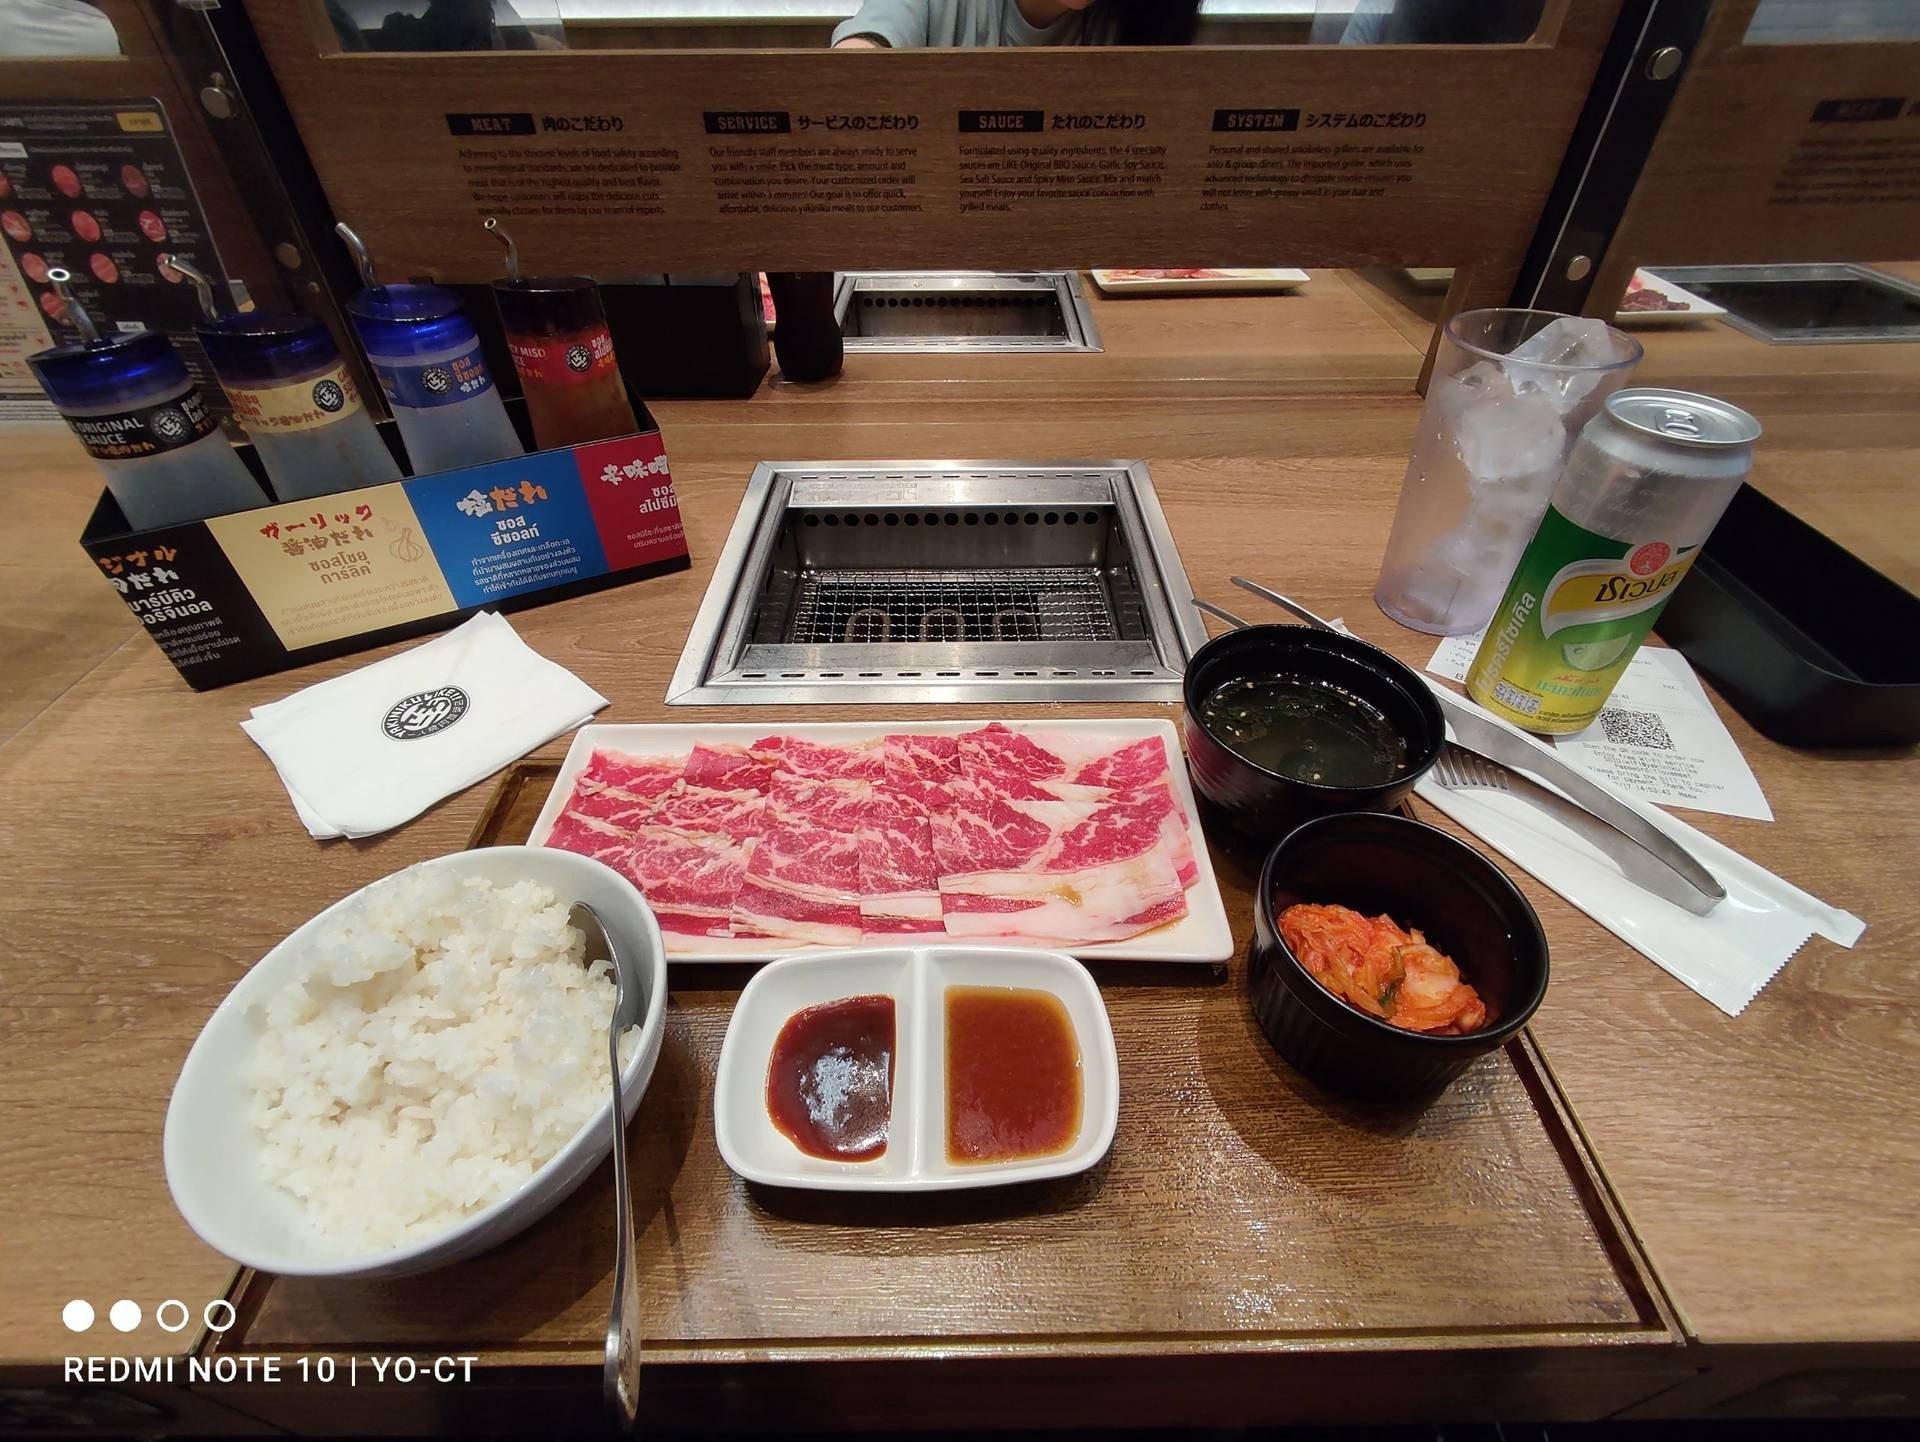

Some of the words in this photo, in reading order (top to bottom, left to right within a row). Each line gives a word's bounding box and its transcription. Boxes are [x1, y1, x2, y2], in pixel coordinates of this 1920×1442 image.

[470, 118, 512, 131] MEAT
[718, 116, 777, 130] SERVICE
[797, 115, 918, 130] サービスのこだわり
[979, 115, 1024, 129] SAUCE
[1052, 114, 1145, 129] たれのこだわり
[1228, 114, 1285, 127] SYSTEM
[1306, 113, 1426, 128] システムのこだわり
[520, 347, 546, 358] MISO
[77, 417, 145, 434] ORIGINAL
[84, 433, 127, 445] SAUCE
[456, 480, 548, 518] 塩だれ
[260, 504, 374, 540] ガーリック
[496, 515, 527, 531] ซอส
[281, 525, 375, 557] 醤油だれ
[308, 551, 371, 571] ซอสโชยุ
[320, 564, 372, 585] การ์ลิค
[386, 695, 423, 738] YAKINIKU
